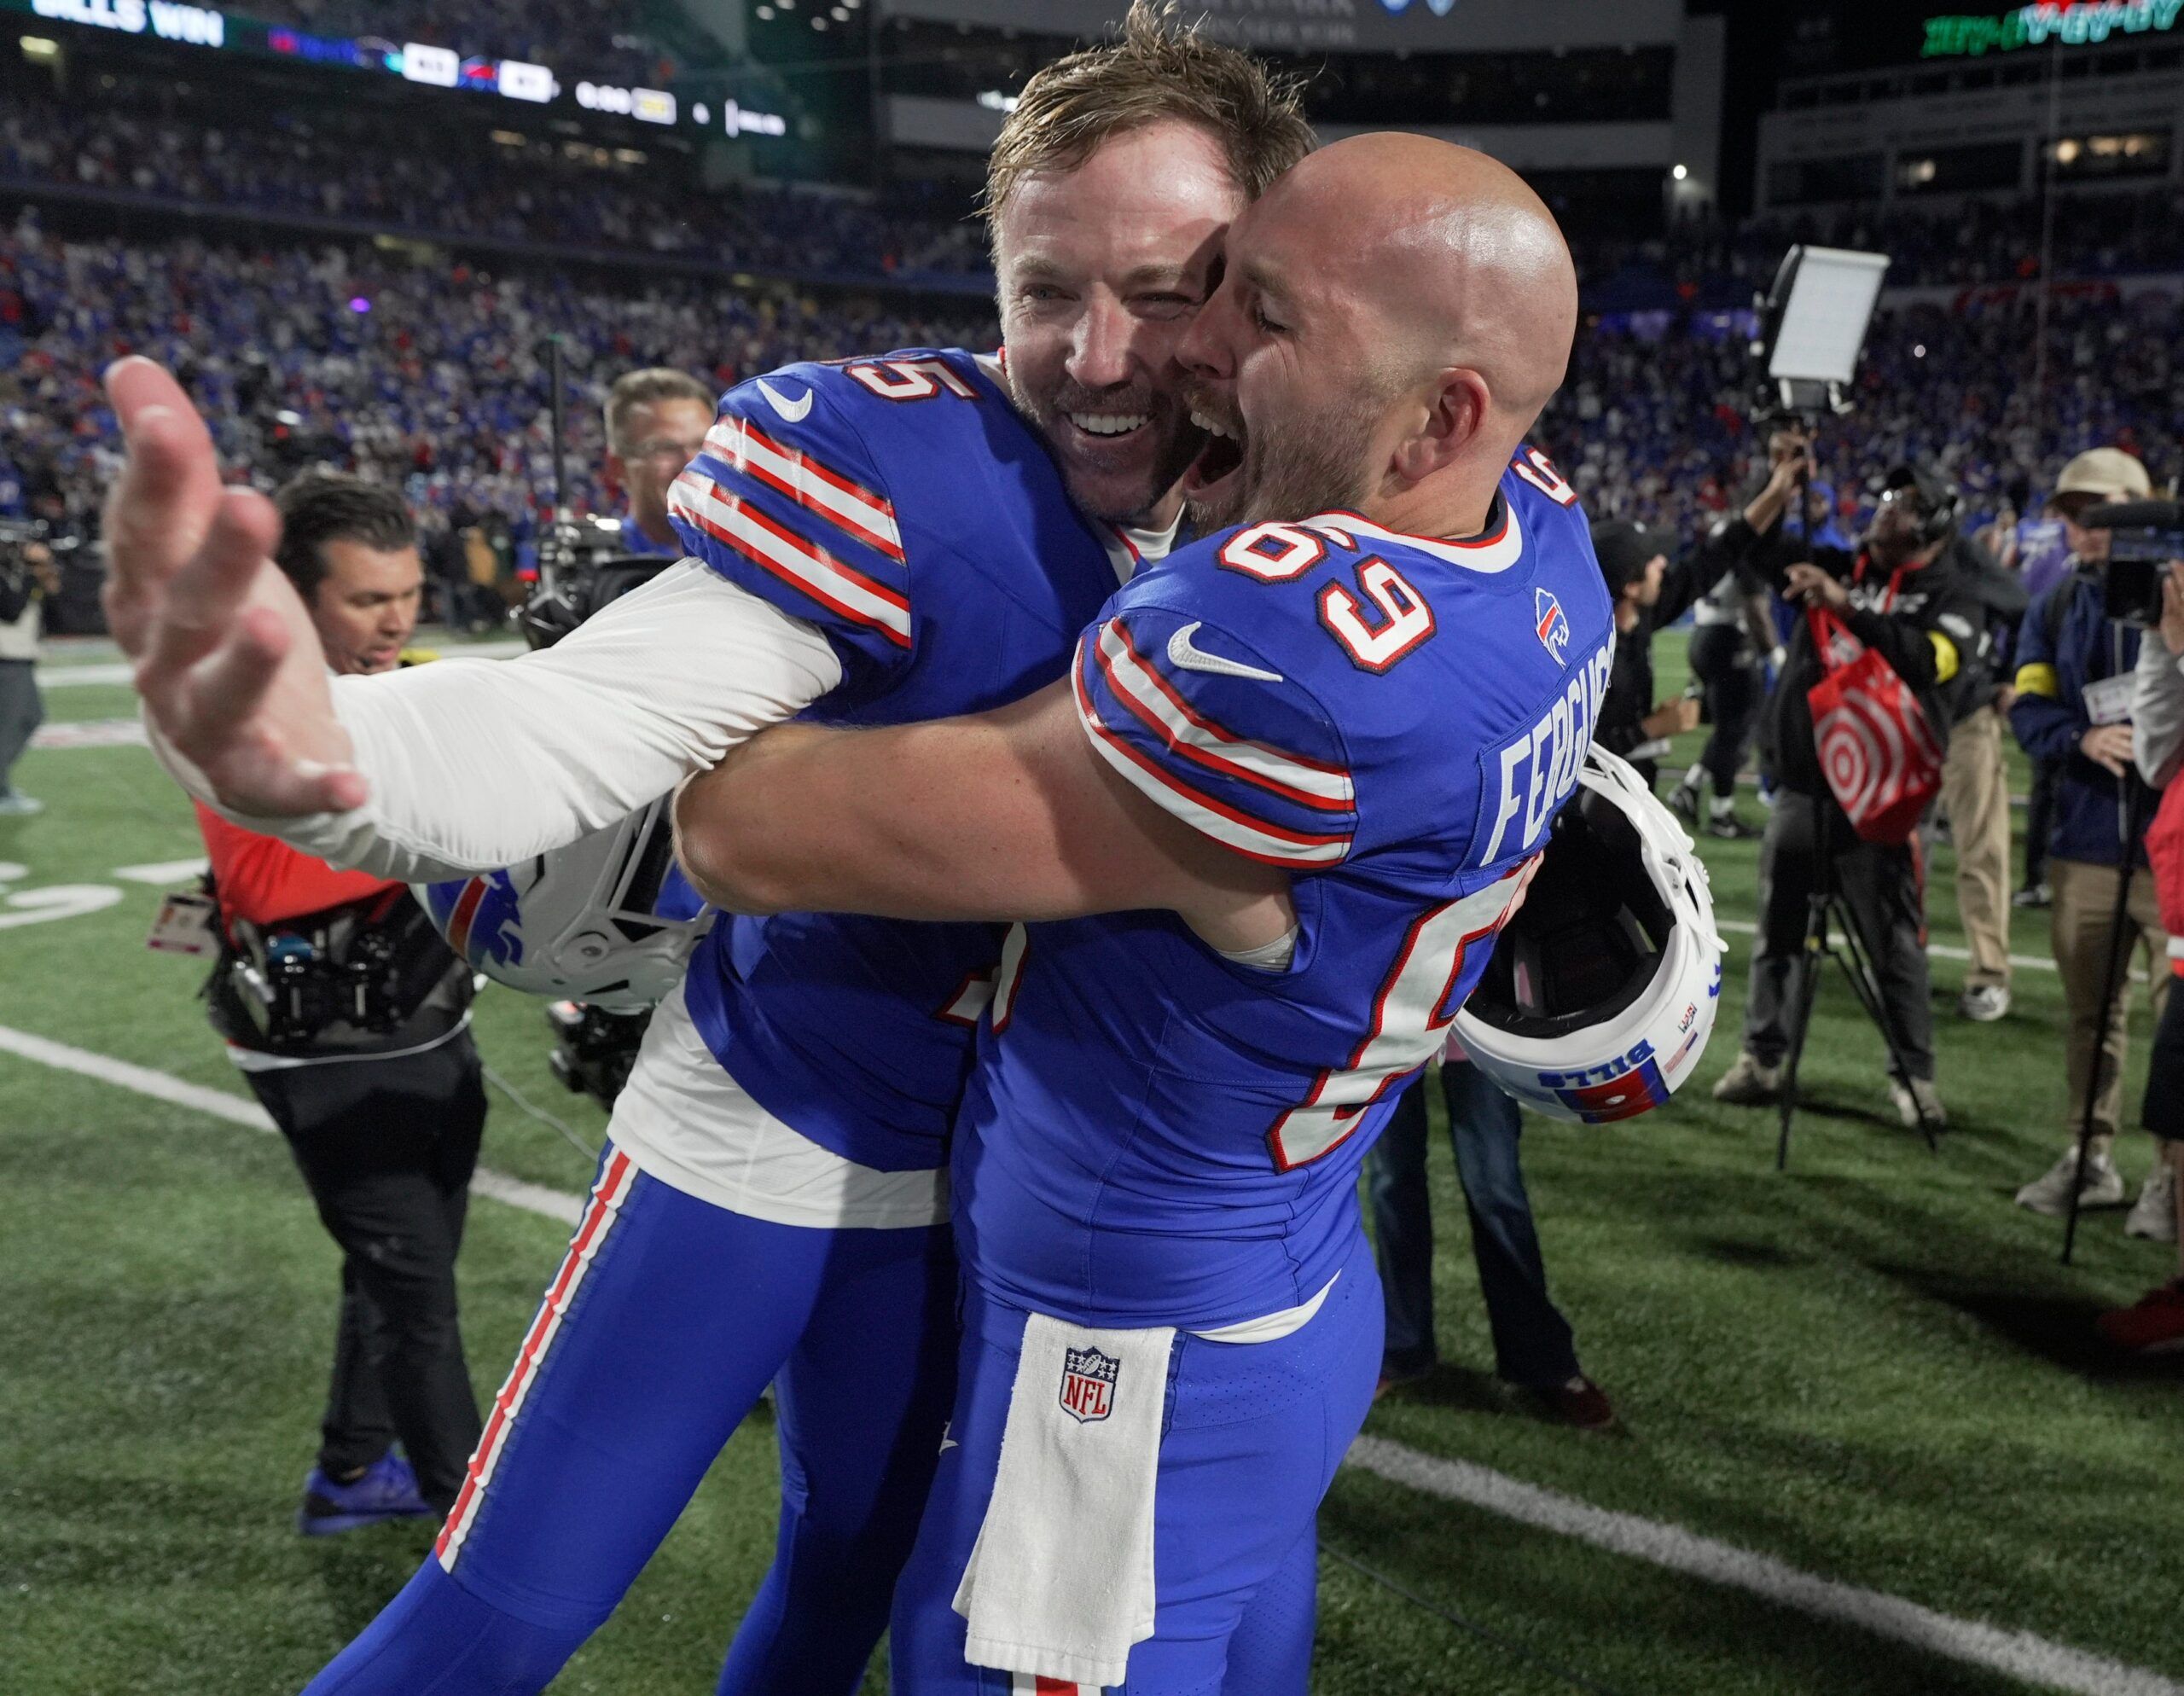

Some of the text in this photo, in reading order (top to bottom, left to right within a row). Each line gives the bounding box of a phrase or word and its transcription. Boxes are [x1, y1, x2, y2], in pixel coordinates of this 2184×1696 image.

[1216, 520, 1438, 677] 69
[1537, 1038, 1656, 1089] BILLS
[1063, 1374, 1107, 1415] NFL
